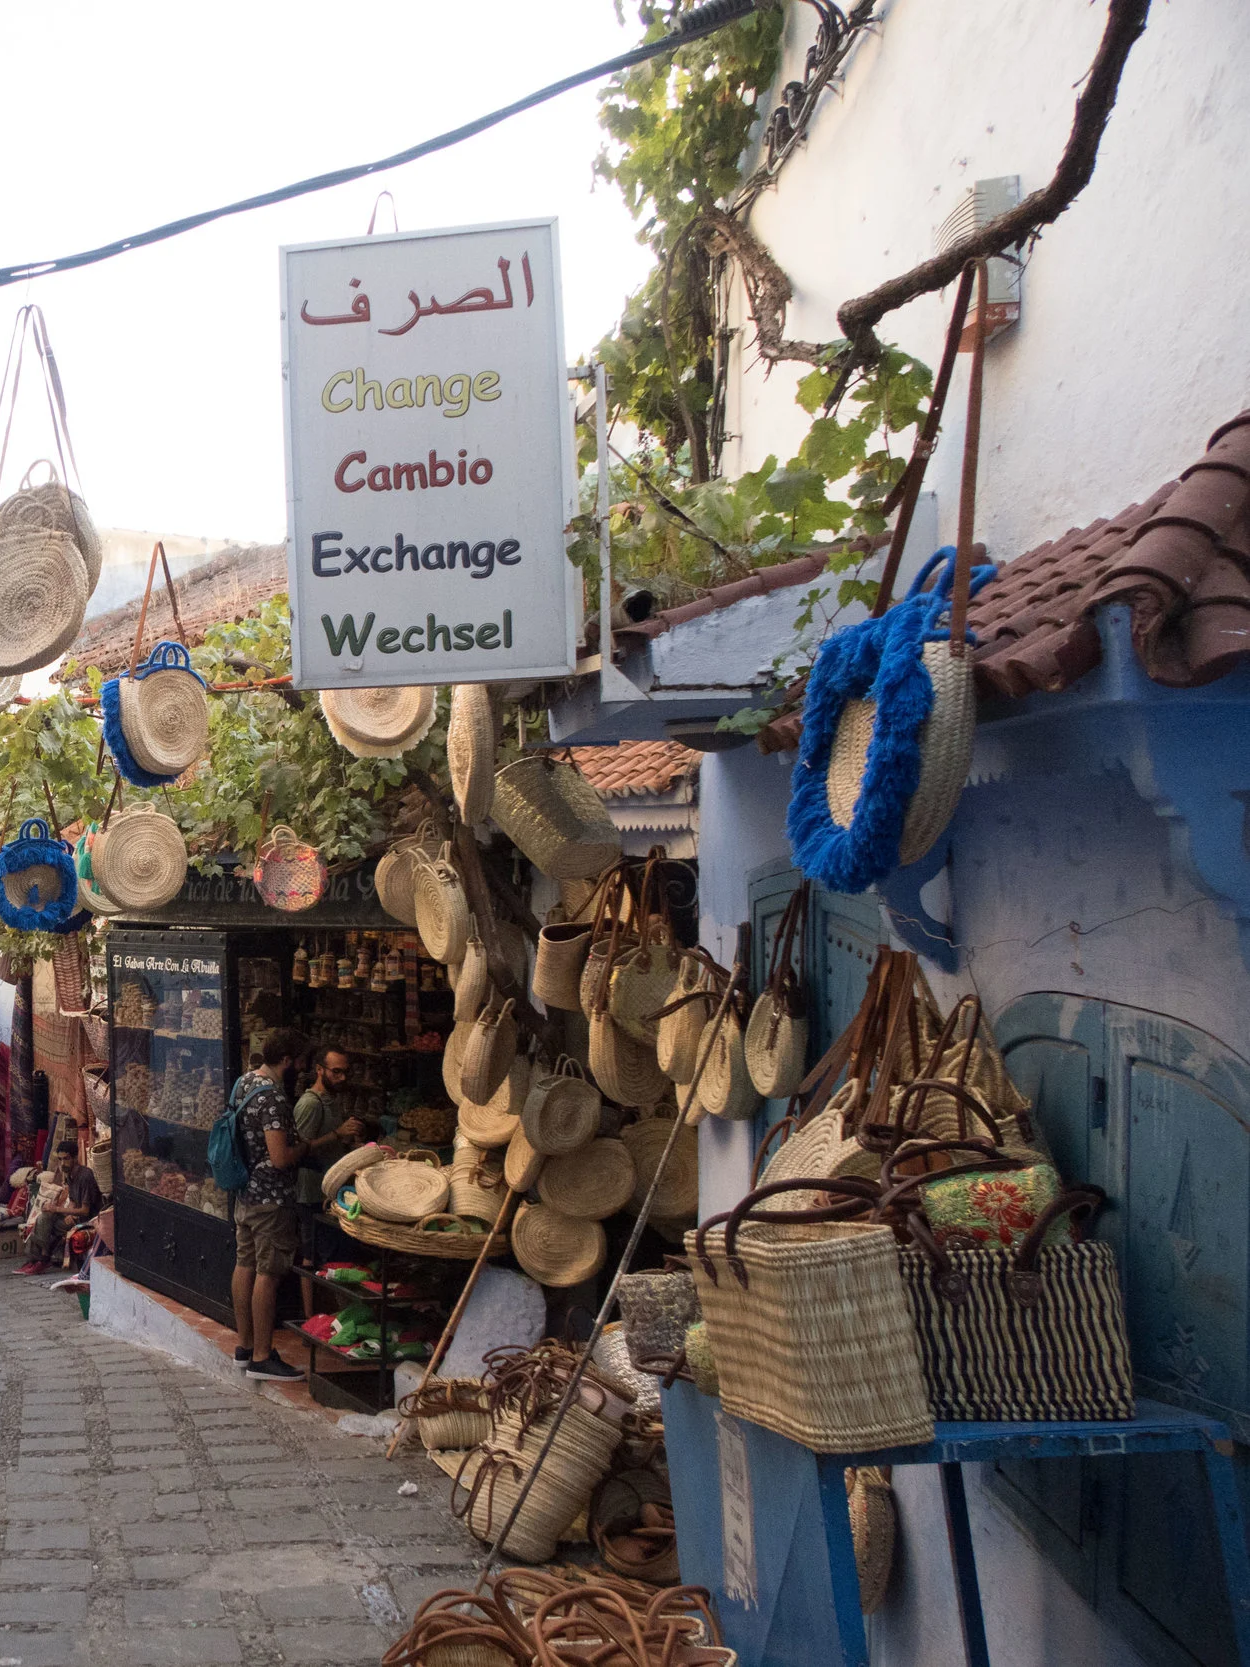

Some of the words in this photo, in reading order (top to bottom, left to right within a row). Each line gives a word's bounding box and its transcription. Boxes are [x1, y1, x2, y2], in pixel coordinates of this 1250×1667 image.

[300, 250, 535, 336] الصرف
[321, 367, 502, 418] Change
[334, 449, 493, 493] Cambio
[312, 531, 522, 579] Exchange
[321, 609, 513, 657] Wechsel
[112, 954, 122, 968] El
[164, 957, 179, 972] Con
[181, 958, 189, 973] La
[190, 958, 220, 974] Abuela
